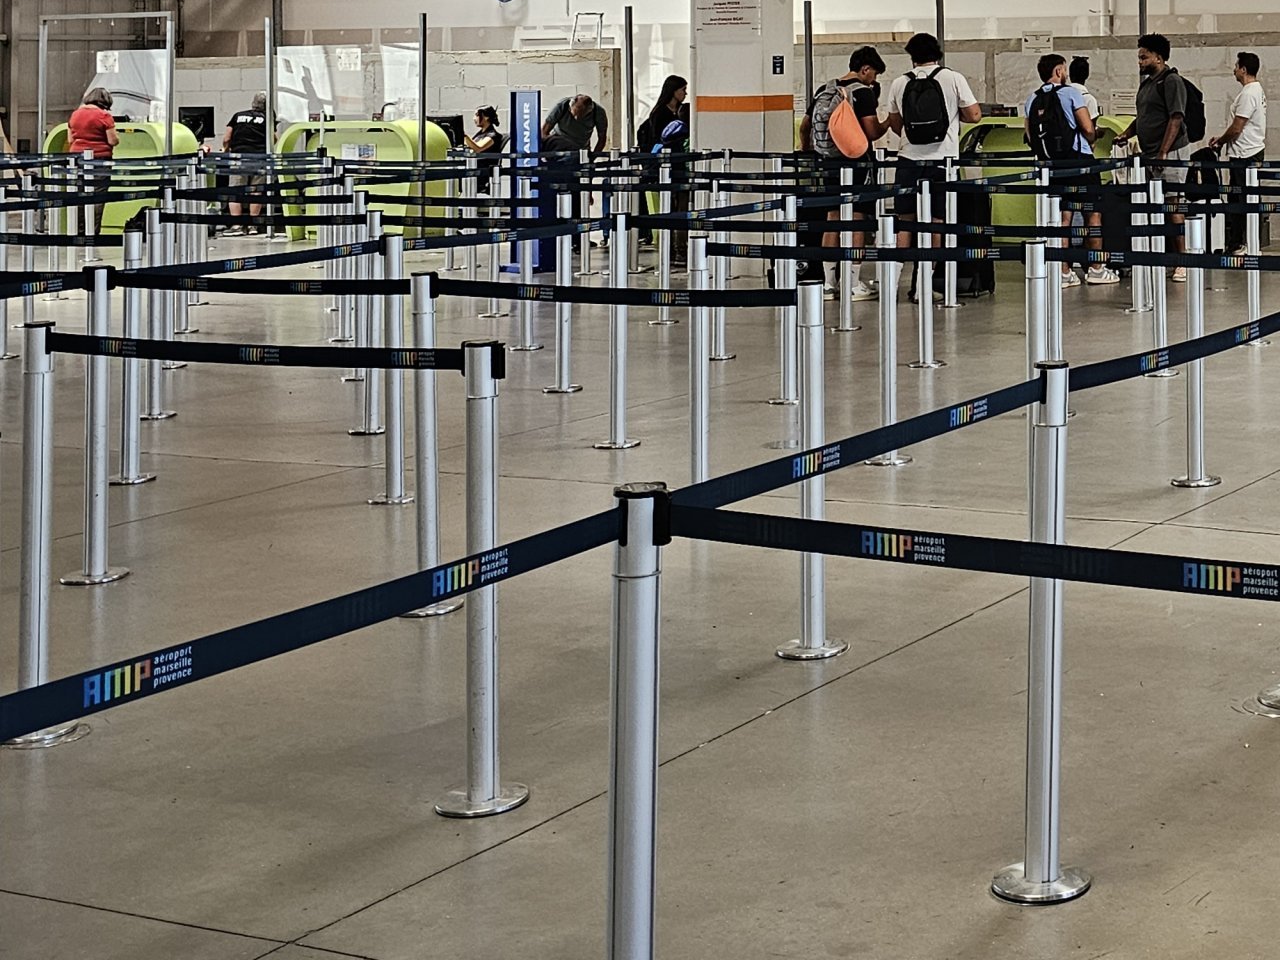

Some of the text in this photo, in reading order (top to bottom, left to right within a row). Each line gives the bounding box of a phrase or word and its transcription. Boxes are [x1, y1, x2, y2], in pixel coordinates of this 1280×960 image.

[862, 531, 912, 558] AMP
[432, 558, 479, 597] AMP
[1183, 562, 1240, 591] AMP
[84, 659, 152, 708] AMP
